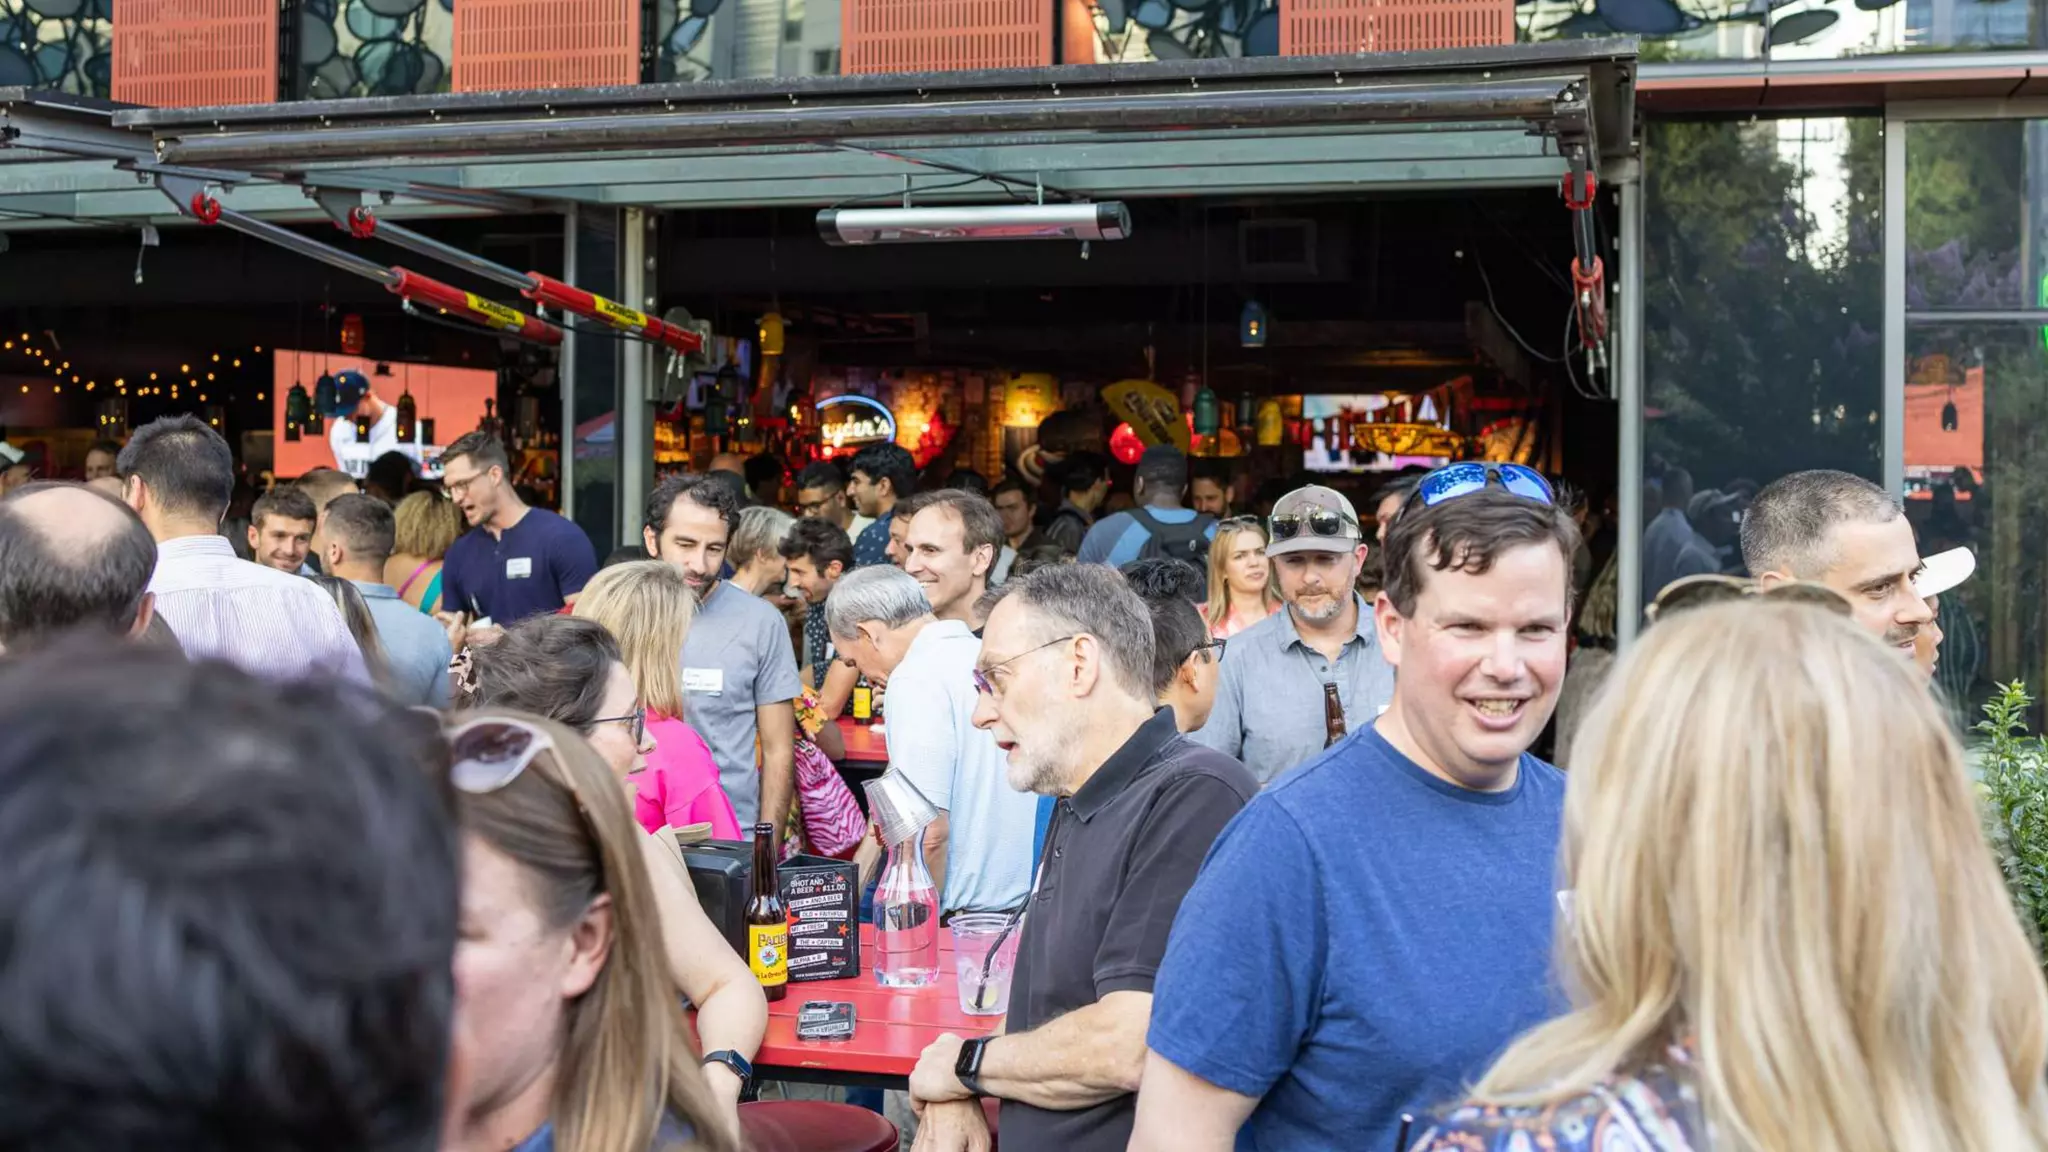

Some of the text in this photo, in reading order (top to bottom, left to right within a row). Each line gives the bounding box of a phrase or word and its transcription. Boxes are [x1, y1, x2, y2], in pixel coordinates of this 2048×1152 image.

[790, 878, 824, 888] SHOT AND
[796, 886, 814, 894] BEER
[822, 883, 846, 892] $11.00
[757, 932, 787, 948] PACIF
